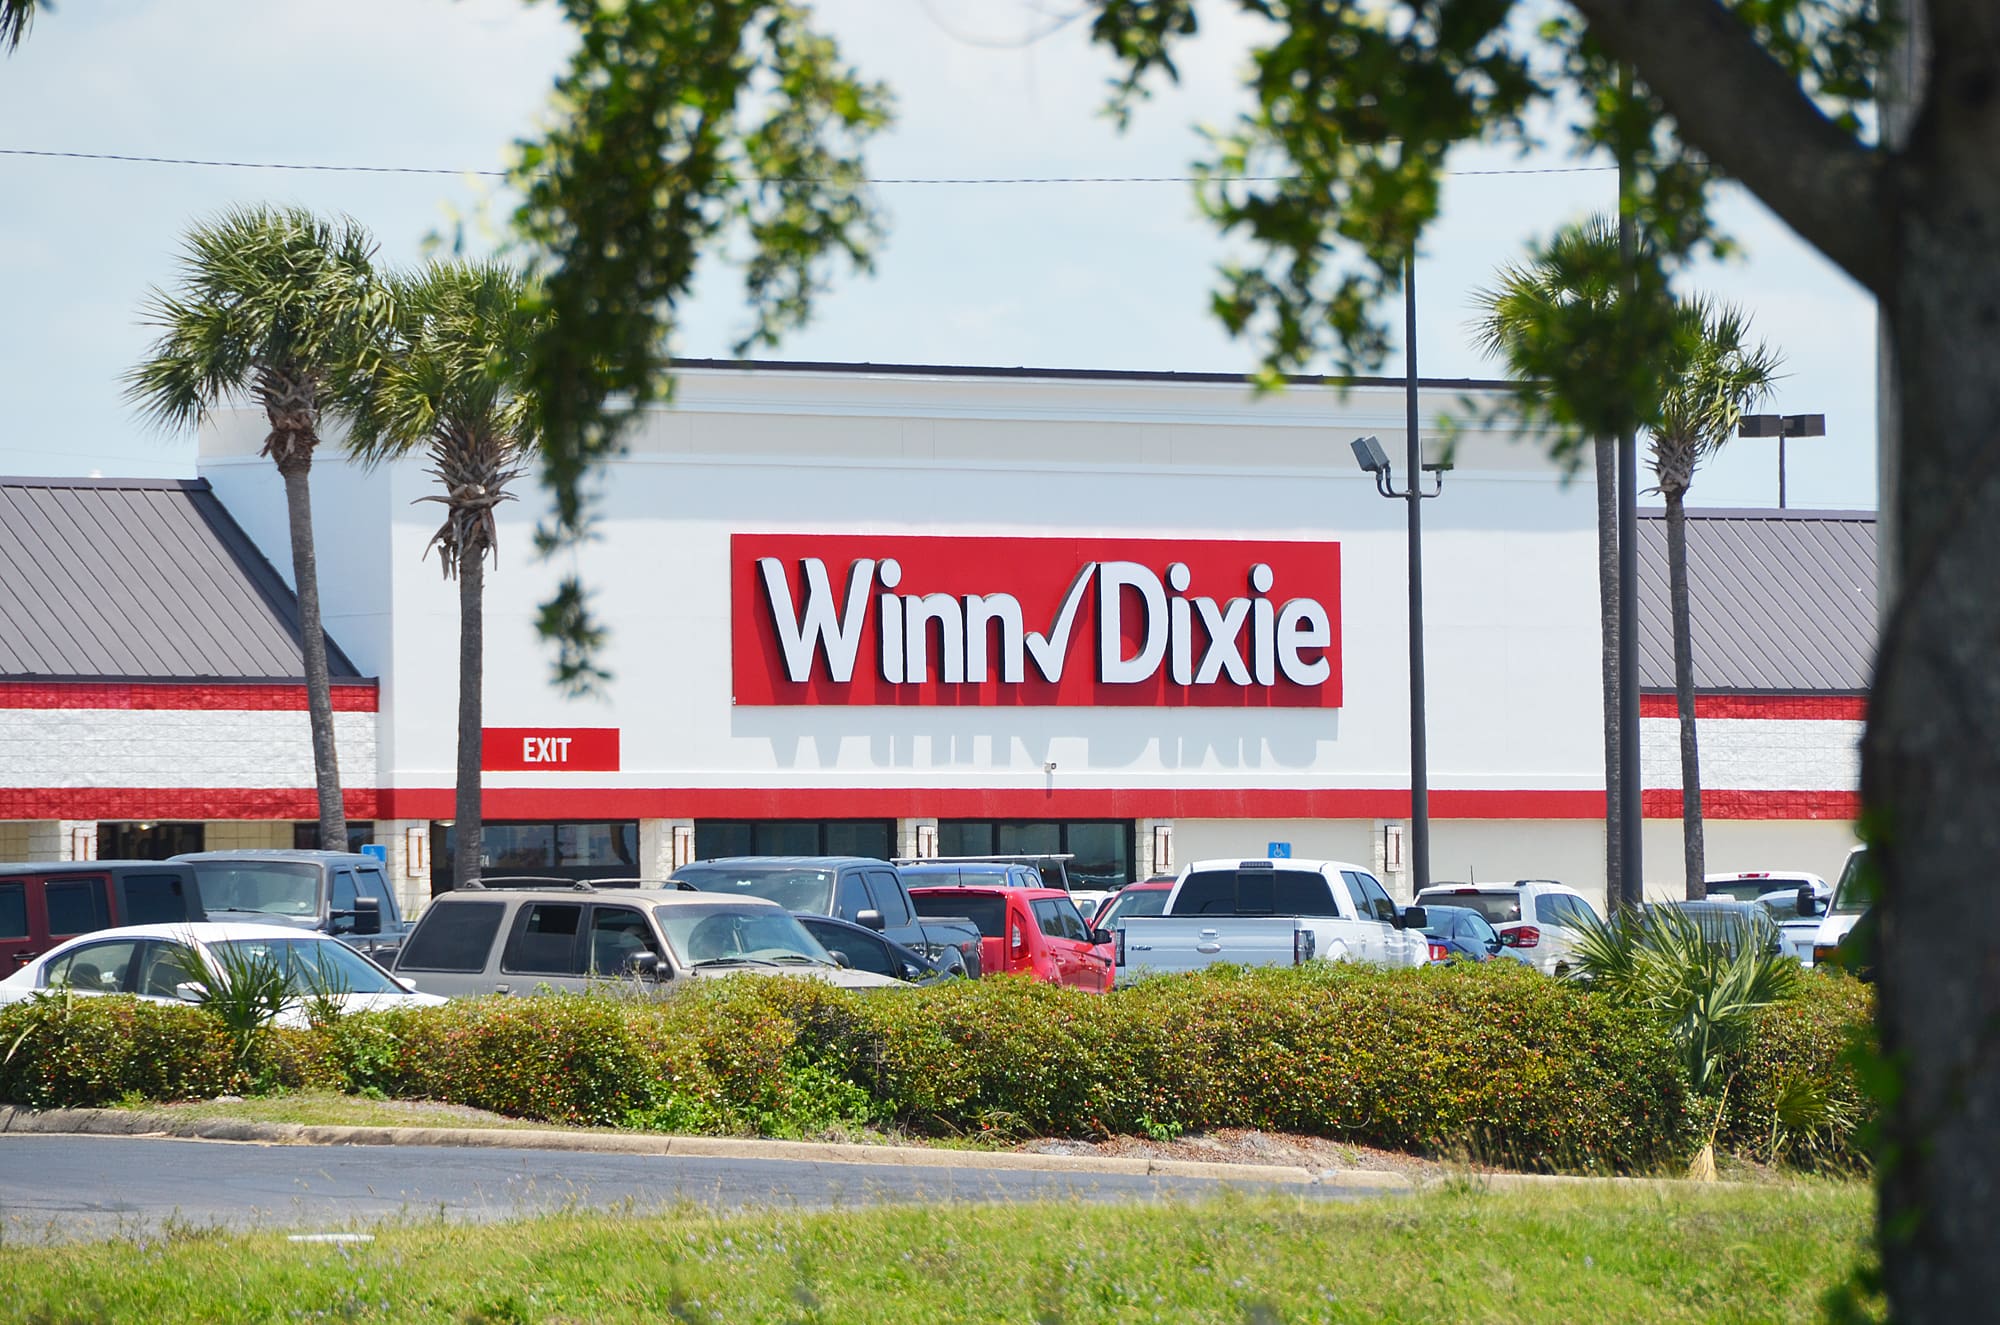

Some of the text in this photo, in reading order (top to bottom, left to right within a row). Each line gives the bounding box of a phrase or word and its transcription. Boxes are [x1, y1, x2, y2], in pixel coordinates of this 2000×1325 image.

[756, 557, 1332, 687] Winn Dixie
[523, 736, 572, 763] EXIT
